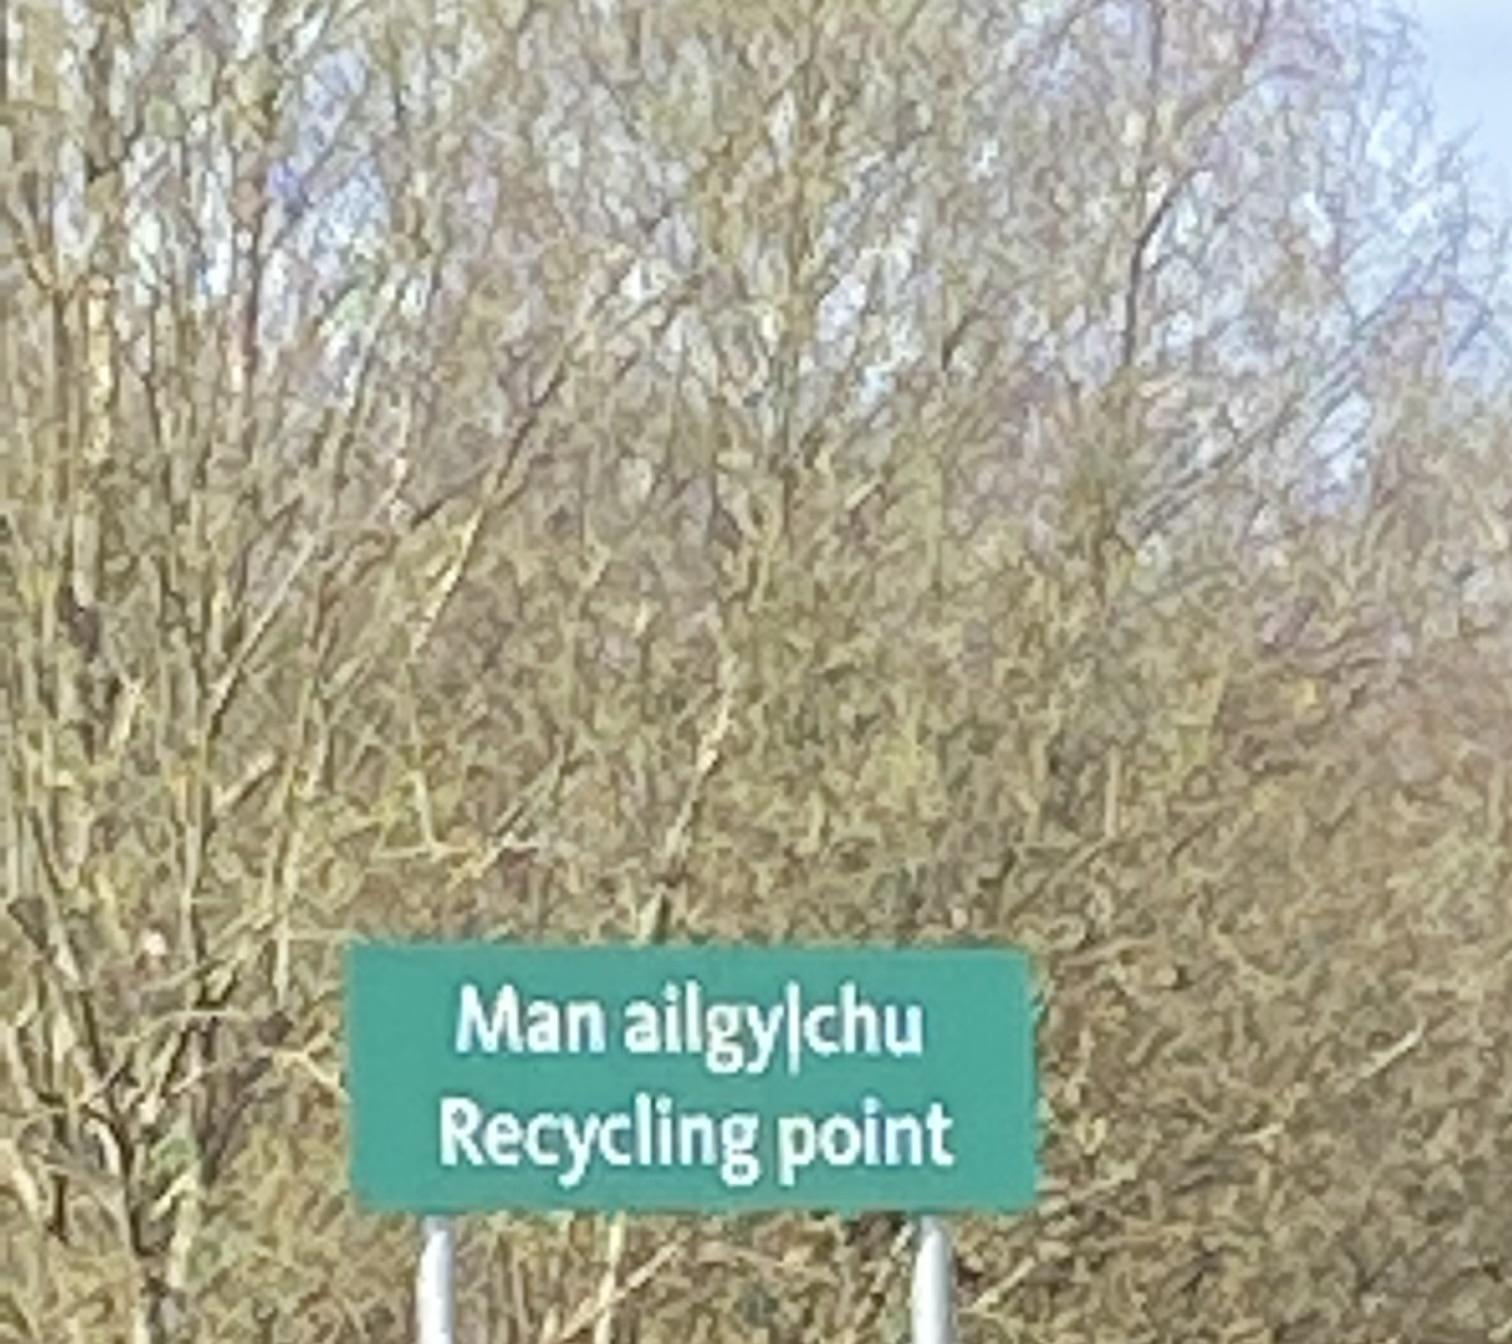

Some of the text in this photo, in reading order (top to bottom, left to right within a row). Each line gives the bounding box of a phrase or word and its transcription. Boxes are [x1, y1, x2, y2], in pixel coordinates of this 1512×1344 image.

[456, 984, 606, 1053] Man
[440, 1092, 955, 1187] Recycling point
